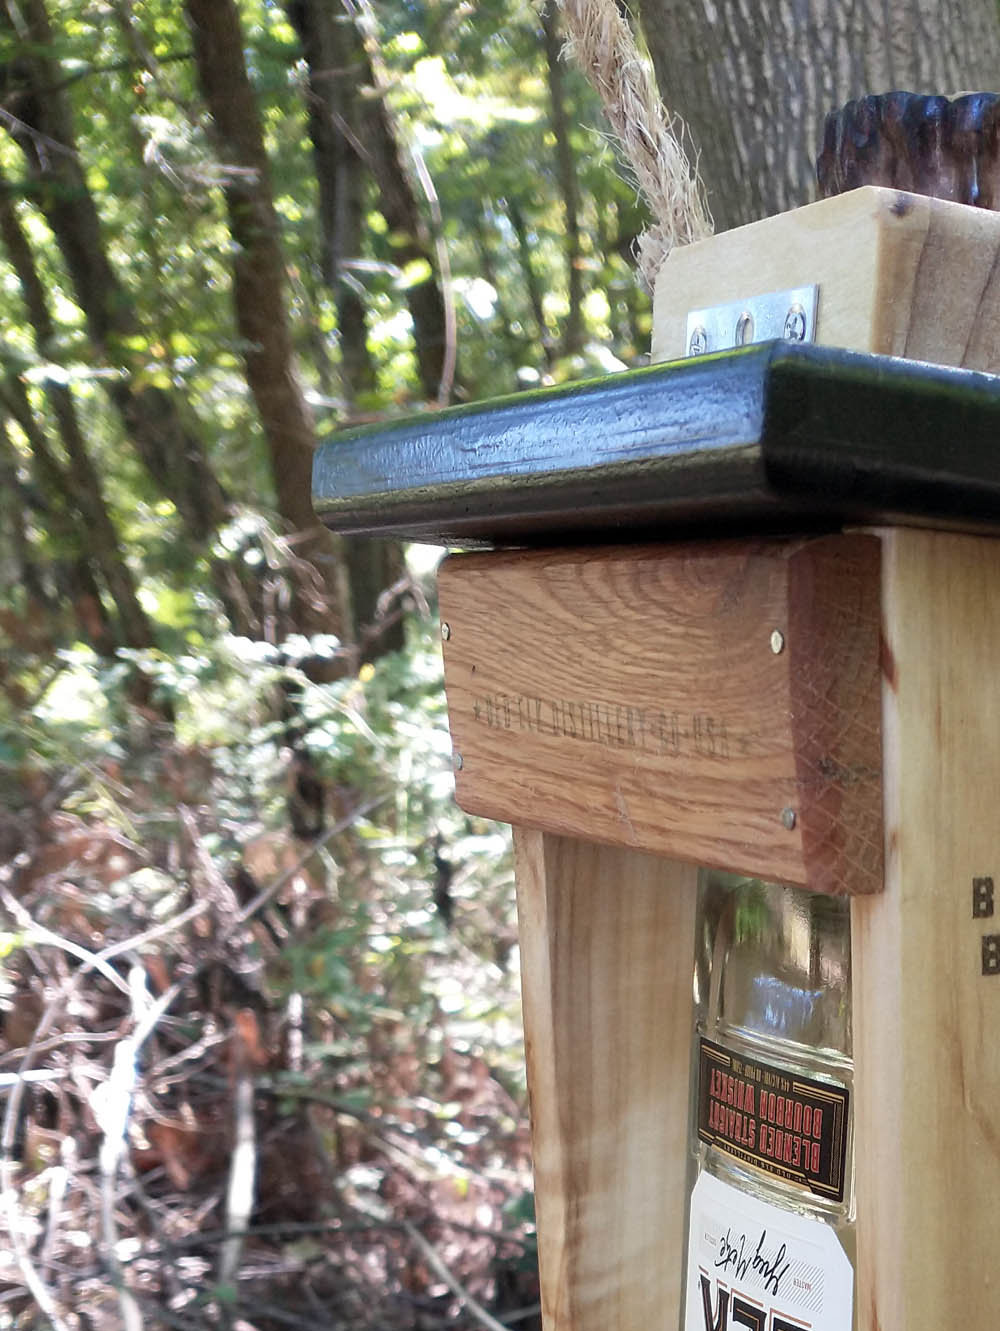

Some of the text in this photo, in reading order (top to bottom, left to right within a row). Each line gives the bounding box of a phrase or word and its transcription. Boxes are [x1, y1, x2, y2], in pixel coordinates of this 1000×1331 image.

[710, 1068, 755, 1116] WHISKEY
[759, 1089, 823, 1139] BOURBON
[708, 1100, 821, 1173] BLENDED STRAIGHT
